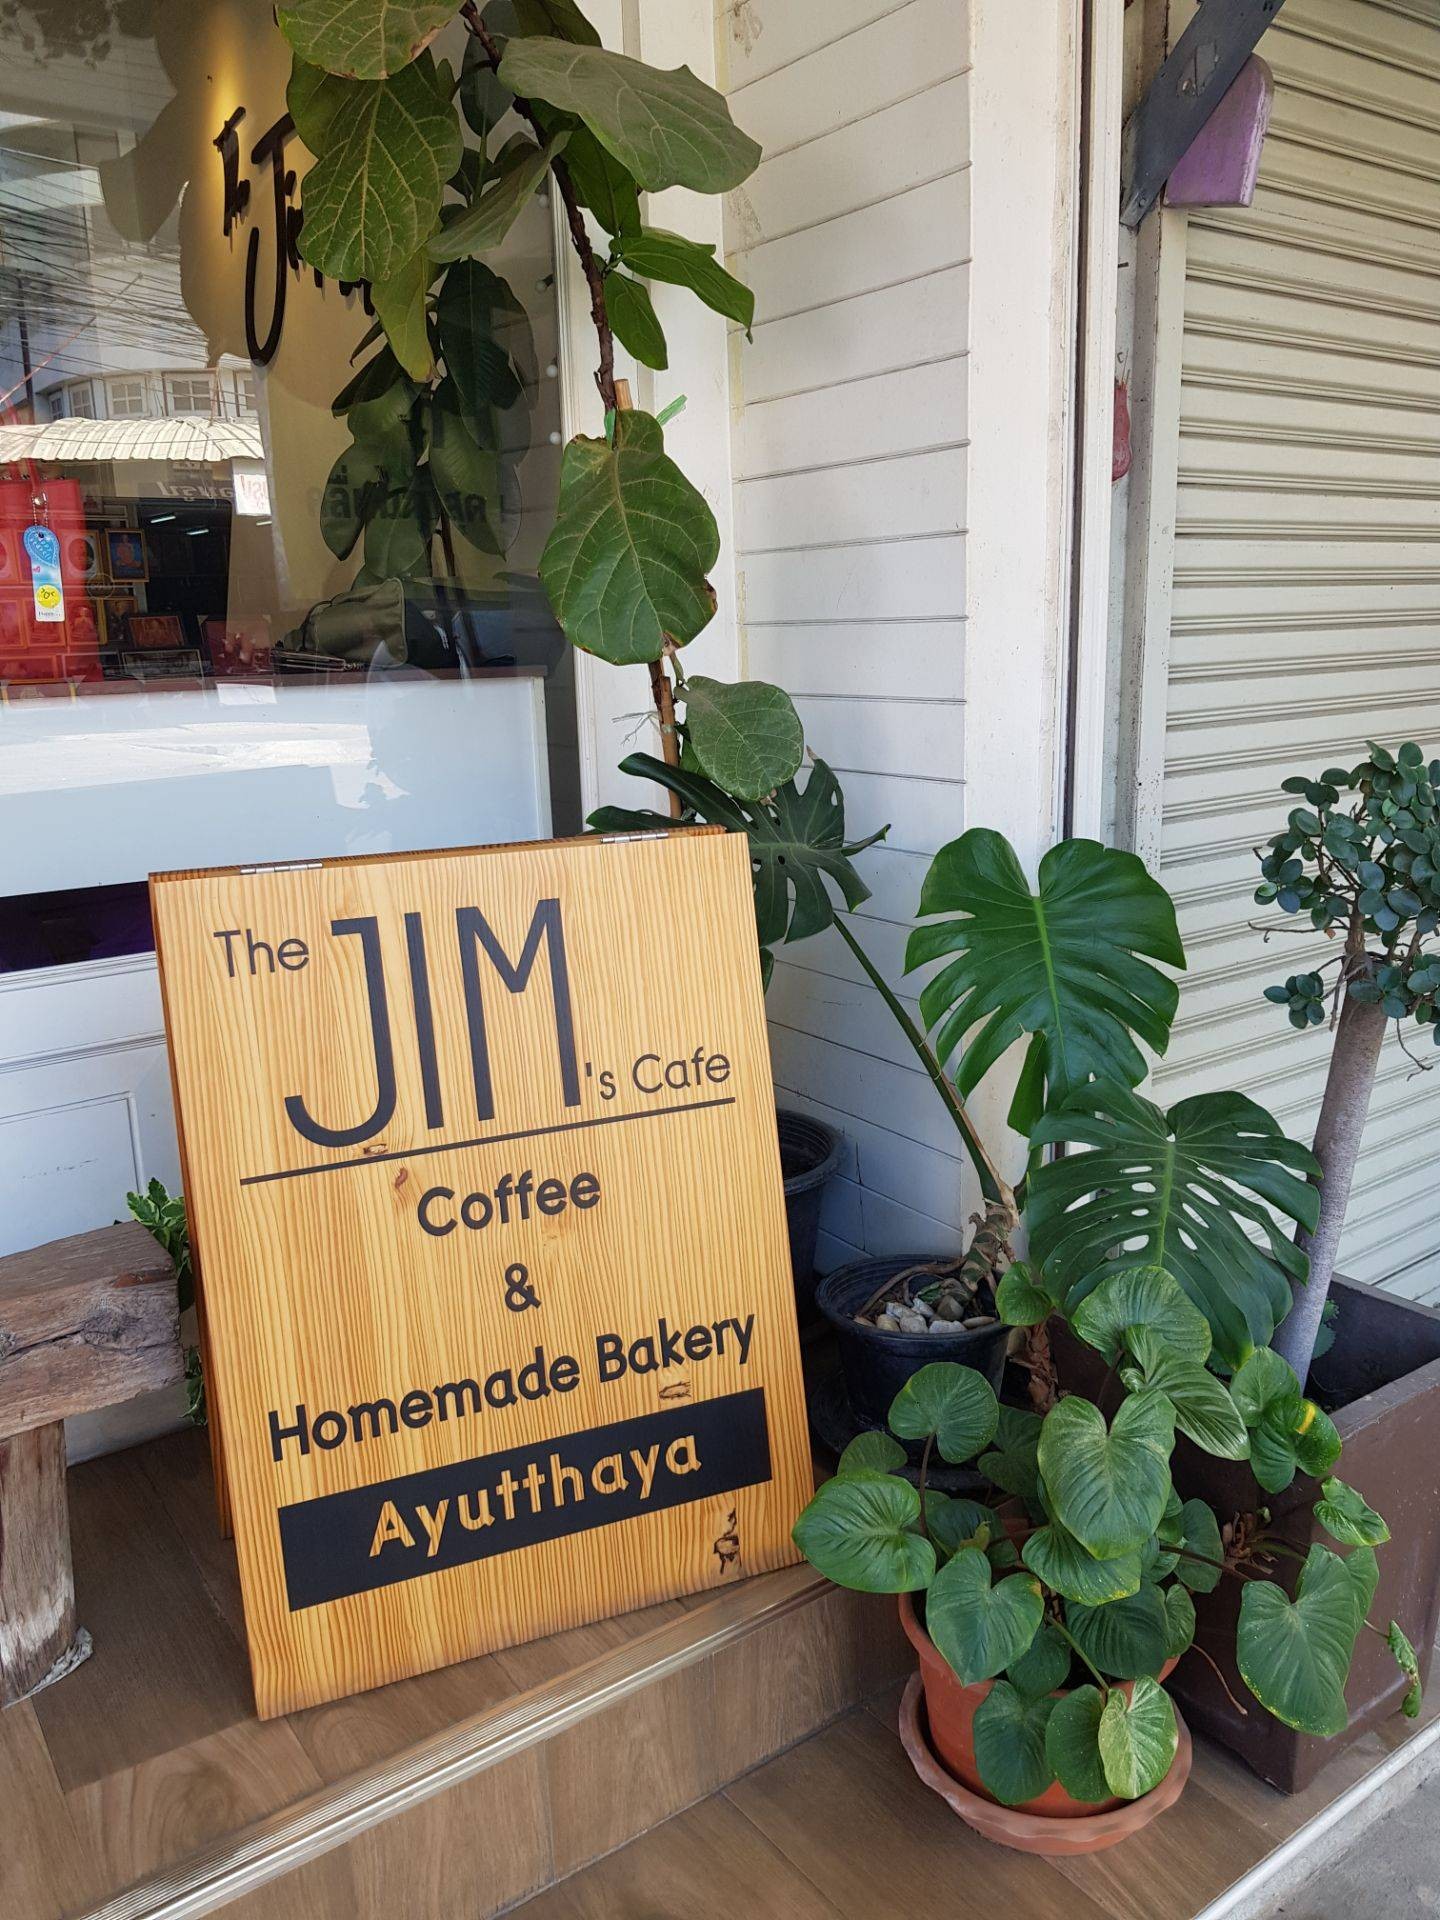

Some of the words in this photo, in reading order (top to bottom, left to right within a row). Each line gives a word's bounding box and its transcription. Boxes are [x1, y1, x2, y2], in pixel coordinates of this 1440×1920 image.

[213, 929, 310, 978] The
[631, 1046, 731, 1095] Cafe
[416, 1169, 602, 1238] Coffee
[503, 1262, 542, 1313] &
[267, 1345, 581, 1464] Homemade
[597, 1313, 756, 1385] Bakery
[368, 1428, 703, 1559] Ayutthaya
